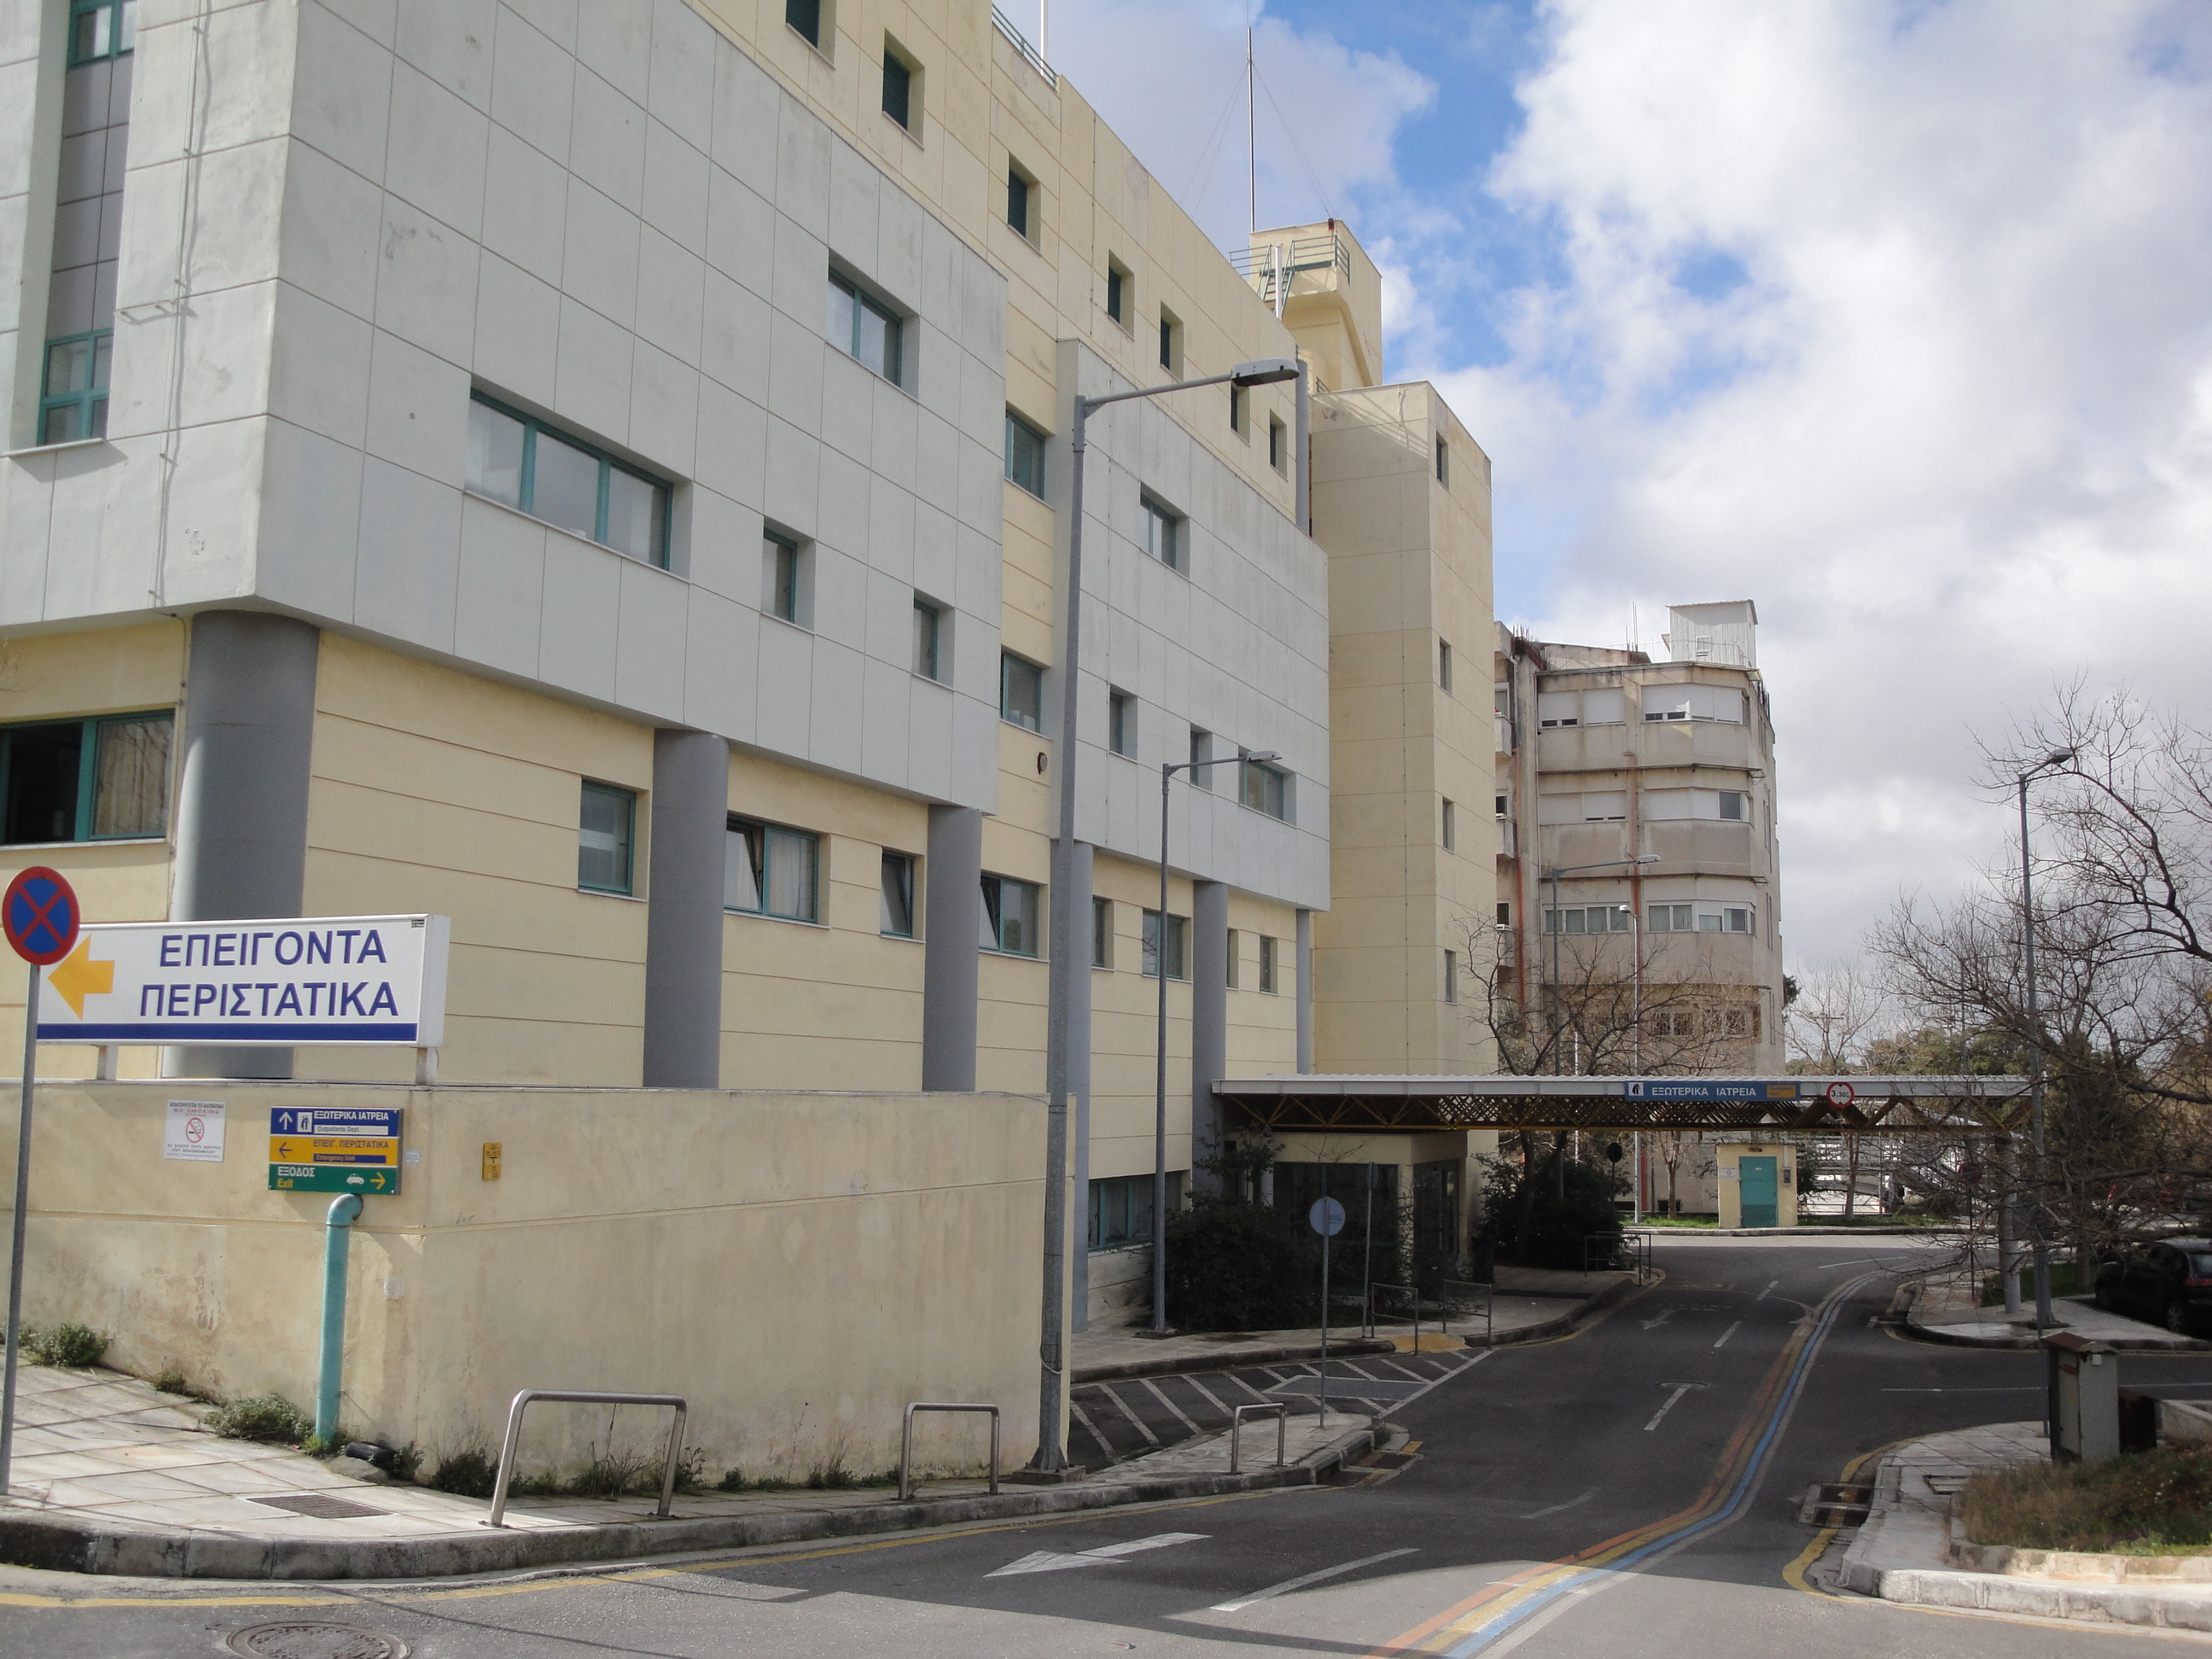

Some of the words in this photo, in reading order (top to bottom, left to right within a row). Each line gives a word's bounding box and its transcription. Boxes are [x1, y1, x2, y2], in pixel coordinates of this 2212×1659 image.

[160, 929, 387, 967] ΕΠΕΙΓΟΝΤΑ
[140, 981, 399, 1018] ΠΕΡΙΣΤΑΤΙΚΑ
[1651, 1087, 1709, 1096] ΕΞΩΤΕΡΙΚΑ
[1716, 1087, 1756, 1096] ΙΑΤΡΕΙΑ
[314, 1110, 358, 1120] ΕΞΩΤΕΡΙΚΑ
[358, 1112, 389, 1121] ΙΑΤΡΕΙΑ
[339, 1140, 389, 1149] ΠΕΡΙΣΤΑΤΙΚΑ
[316, 1154, 344, 1162] Emergency
[277, 1166, 316, 1178] ΕΞΟΔΟΣ
[276, 1178, 294, 1188] Exit
